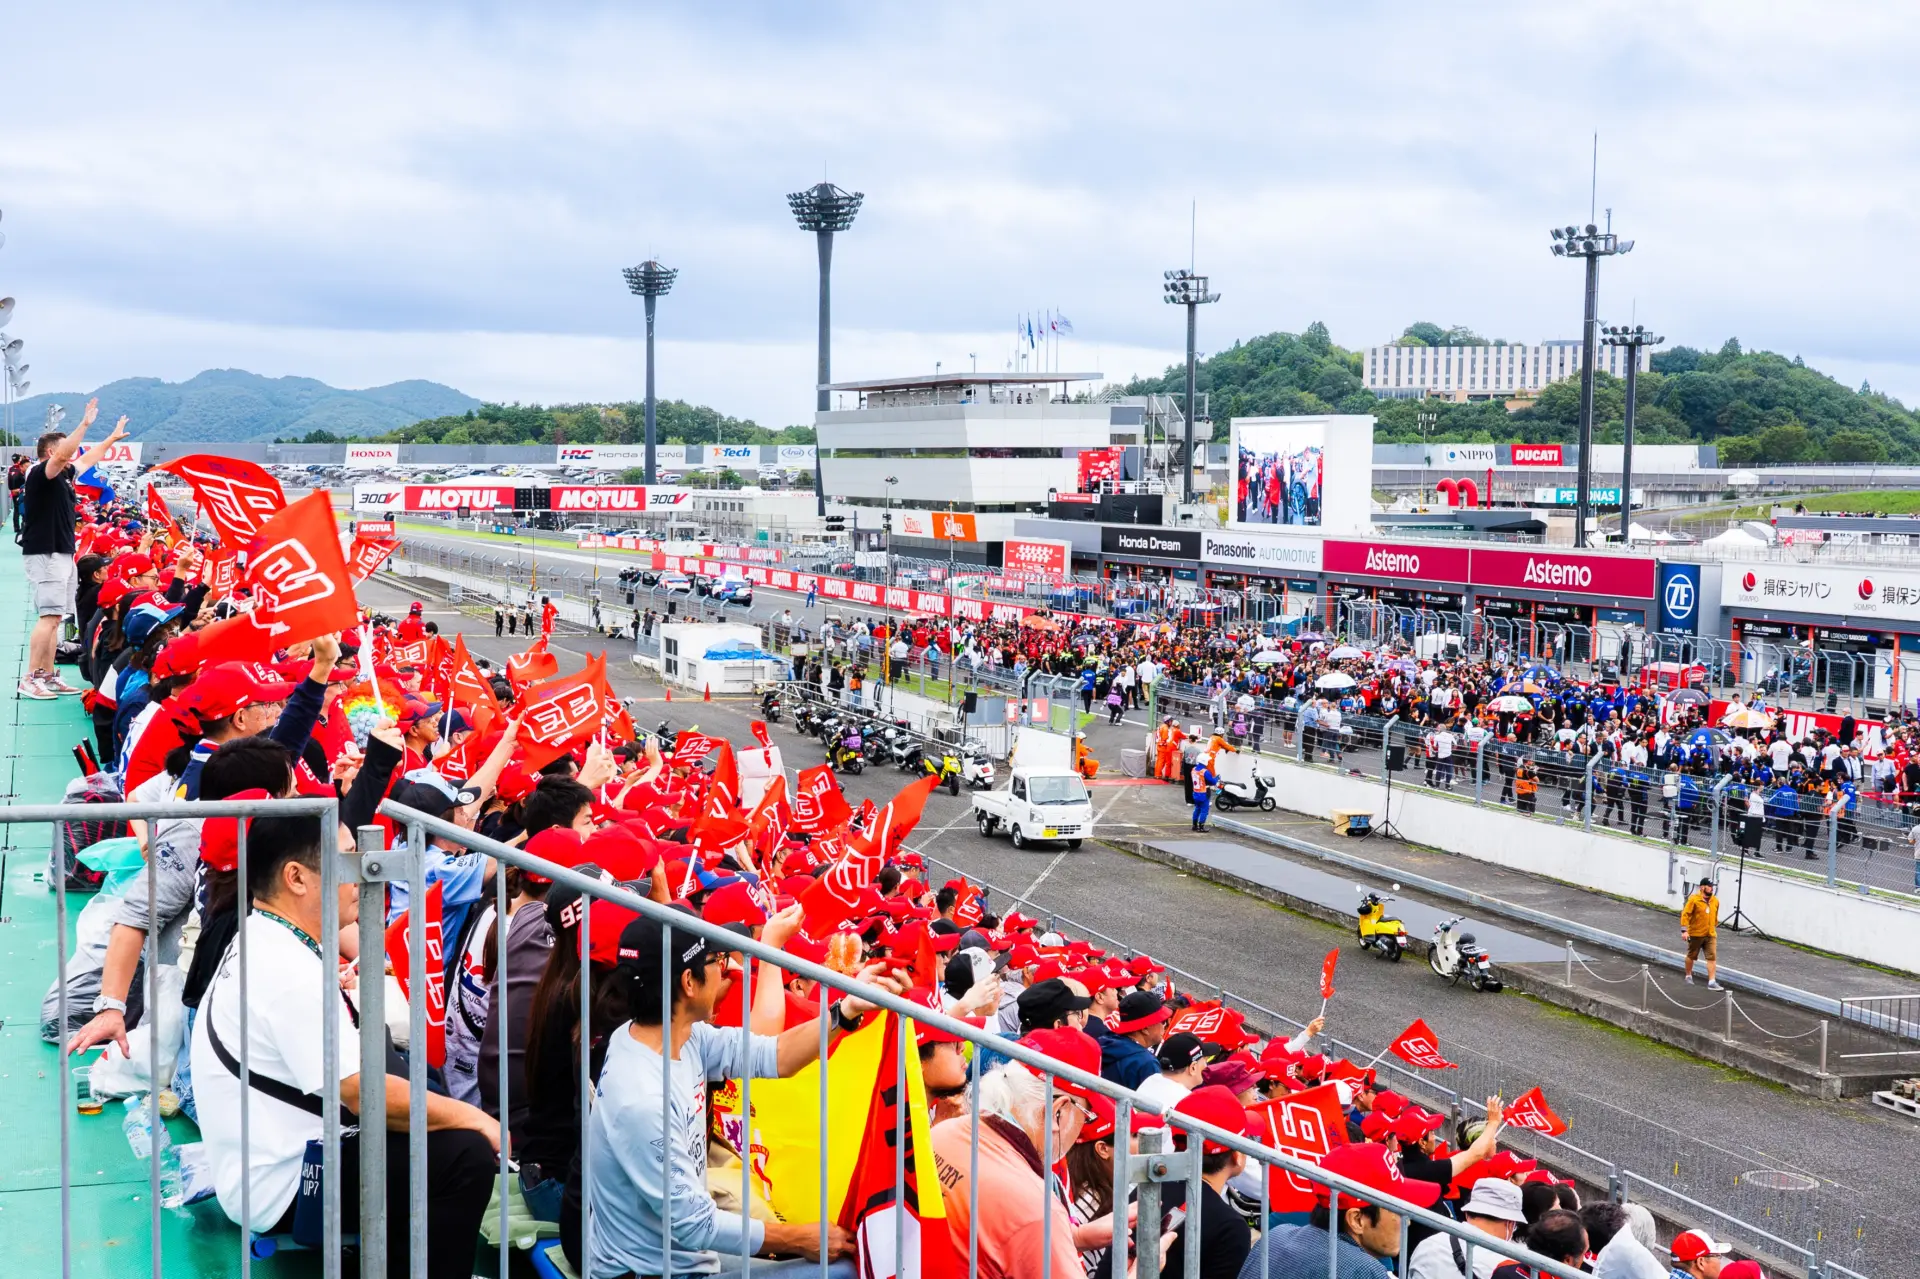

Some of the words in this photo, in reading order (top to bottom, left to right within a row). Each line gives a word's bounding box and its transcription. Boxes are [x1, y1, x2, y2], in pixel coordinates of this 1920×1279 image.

[351, 450, 393, 458] HONDA
[561, 450, 593, 459] HRC
[1460, 450, 1494, 460] NIPPO
[1515, 449, 1559, 461] DUCATI
[359, 492, 401, 504] 300V
[418, 489, 501, 509] MOTUL
[558, 489, 640, 509] MOTUL
[650, 493, 689, 505] 300V
[1560, 490, 1615, 501] PETONAS
[360, 523, 392, 532] MOTUL
[1119, 535, 1148, 549] Honda
[1150, 537, 1181, 551] Dream
[1880, 534, 1910, 545] LEON
[1206, 539, 1256, 559] Panasonic
[1259, 547, 1317, 564] AUTOMOTIVE
[1365, 547, 1420, 574] Astemo
[1523, 557, 1592, 587] Astemo
[824, 578, 847, 596] MOTUL
[853, 583, 878, 602] MOTUL
[1763, 578, 1832, 599] 損保ジャパン
[884, 588, 910, 607] MOTUL
[917, 592, 945, 614] MOTUL
[1669, 583, 1692, 610] ZF
[1738, 594, 1760, 603] SOMPO
[953, 599, 983, 620] MOTUL
[1853, 603, 1877, 612] SOMPO
[560, 897, 583, 929] 93
[619, 948, 639, 957] MOTUL
[302, 1162, 324, 1180] HAT'
[303, 1179, 320, 1198] UP?
